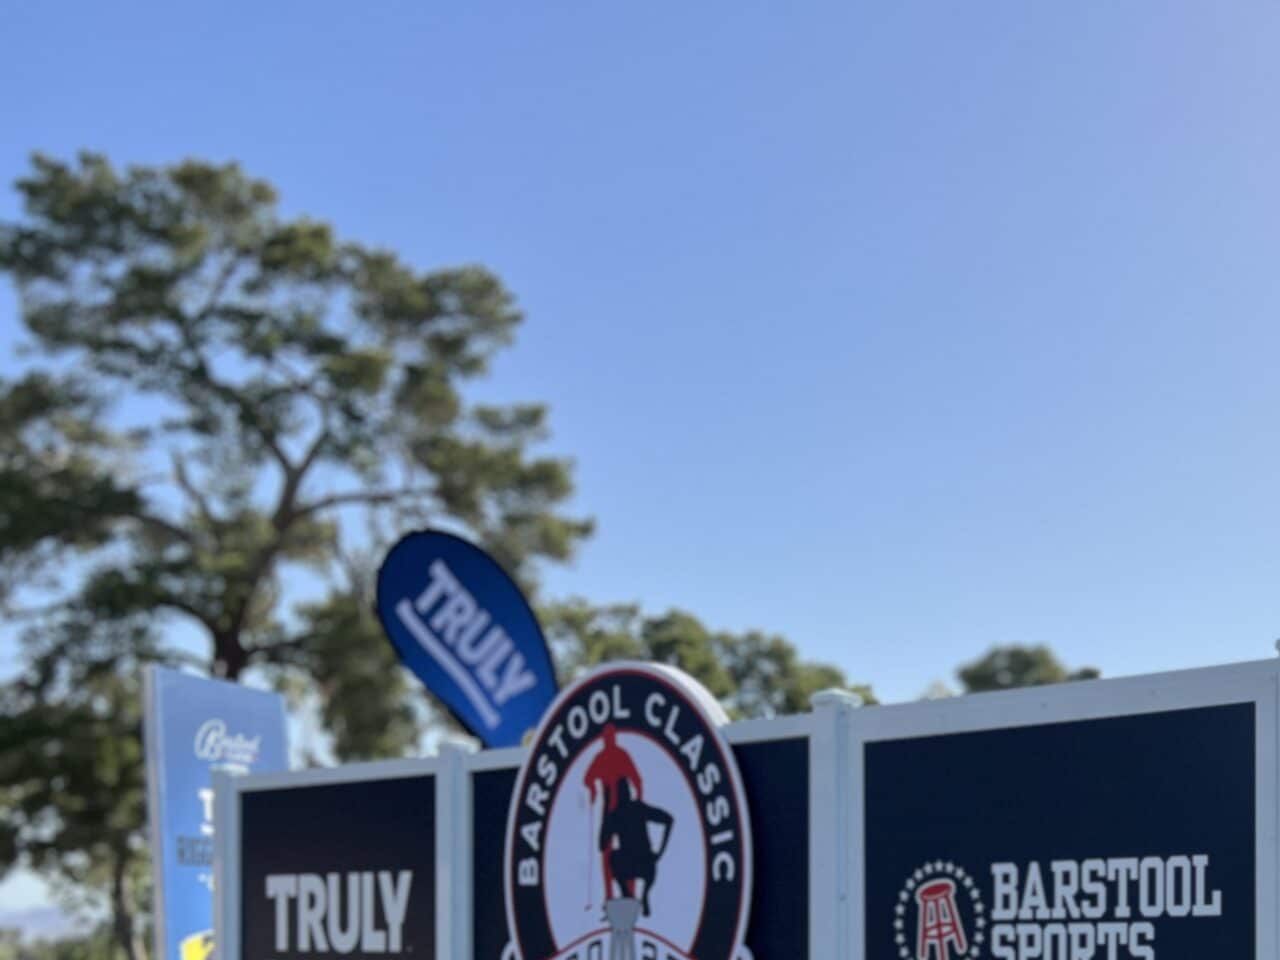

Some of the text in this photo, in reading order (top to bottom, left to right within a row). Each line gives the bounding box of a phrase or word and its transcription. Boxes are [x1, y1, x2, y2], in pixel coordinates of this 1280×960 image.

[413, 558, 538, 704] TRULY
[518, 685, 735, 886] BARSTOOL CLASSIC
[265, 870, 412, 955] TRULY
[990, 854, 1222, 921] BARSTOOL
